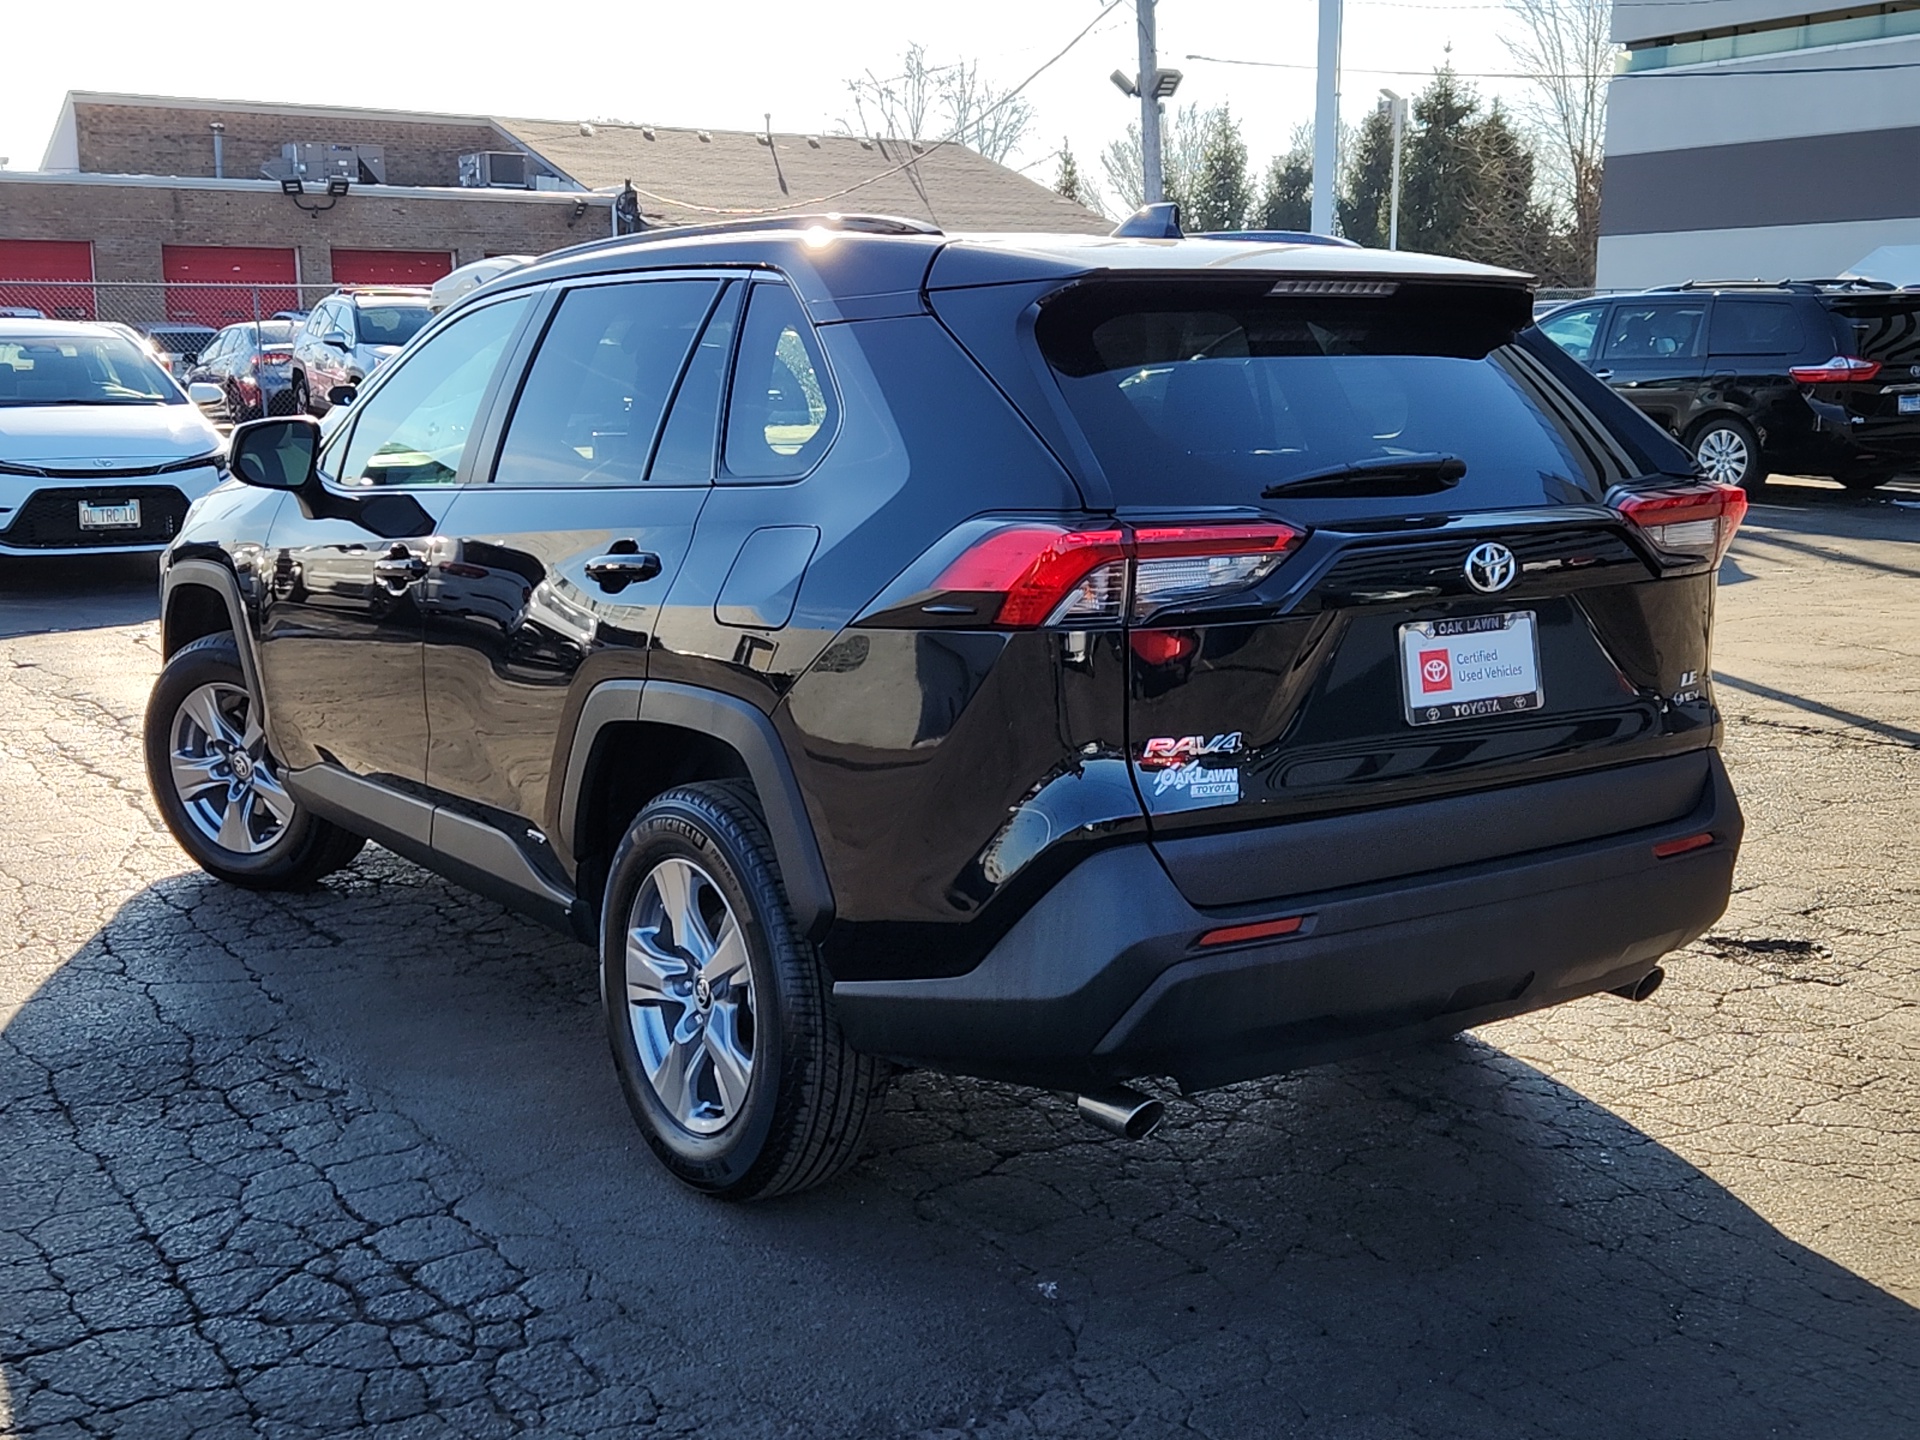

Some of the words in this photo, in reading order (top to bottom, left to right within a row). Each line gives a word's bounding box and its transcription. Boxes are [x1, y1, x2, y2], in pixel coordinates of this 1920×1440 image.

[99, 508, 119, 523] TRC
[123, 507, 136, 522] 10
[1438, 622, 1463, 635] OAK
[1466, 617, 1500, 631] LAWN
[1456, 649, 1498, 665] Certified
[1458, 670, 1483, 682] Used
[1485, 664, 1523, 679] Vehicles
[1680, 669, 1698, 687] LE
[1452, 700, 1501, 717] TOYOTA
[1143, 731, 1242, 757] RAV4
[1197, 784, 1232, 793] TOYOTA
[653, 818, 705, 848] MICHELIN
